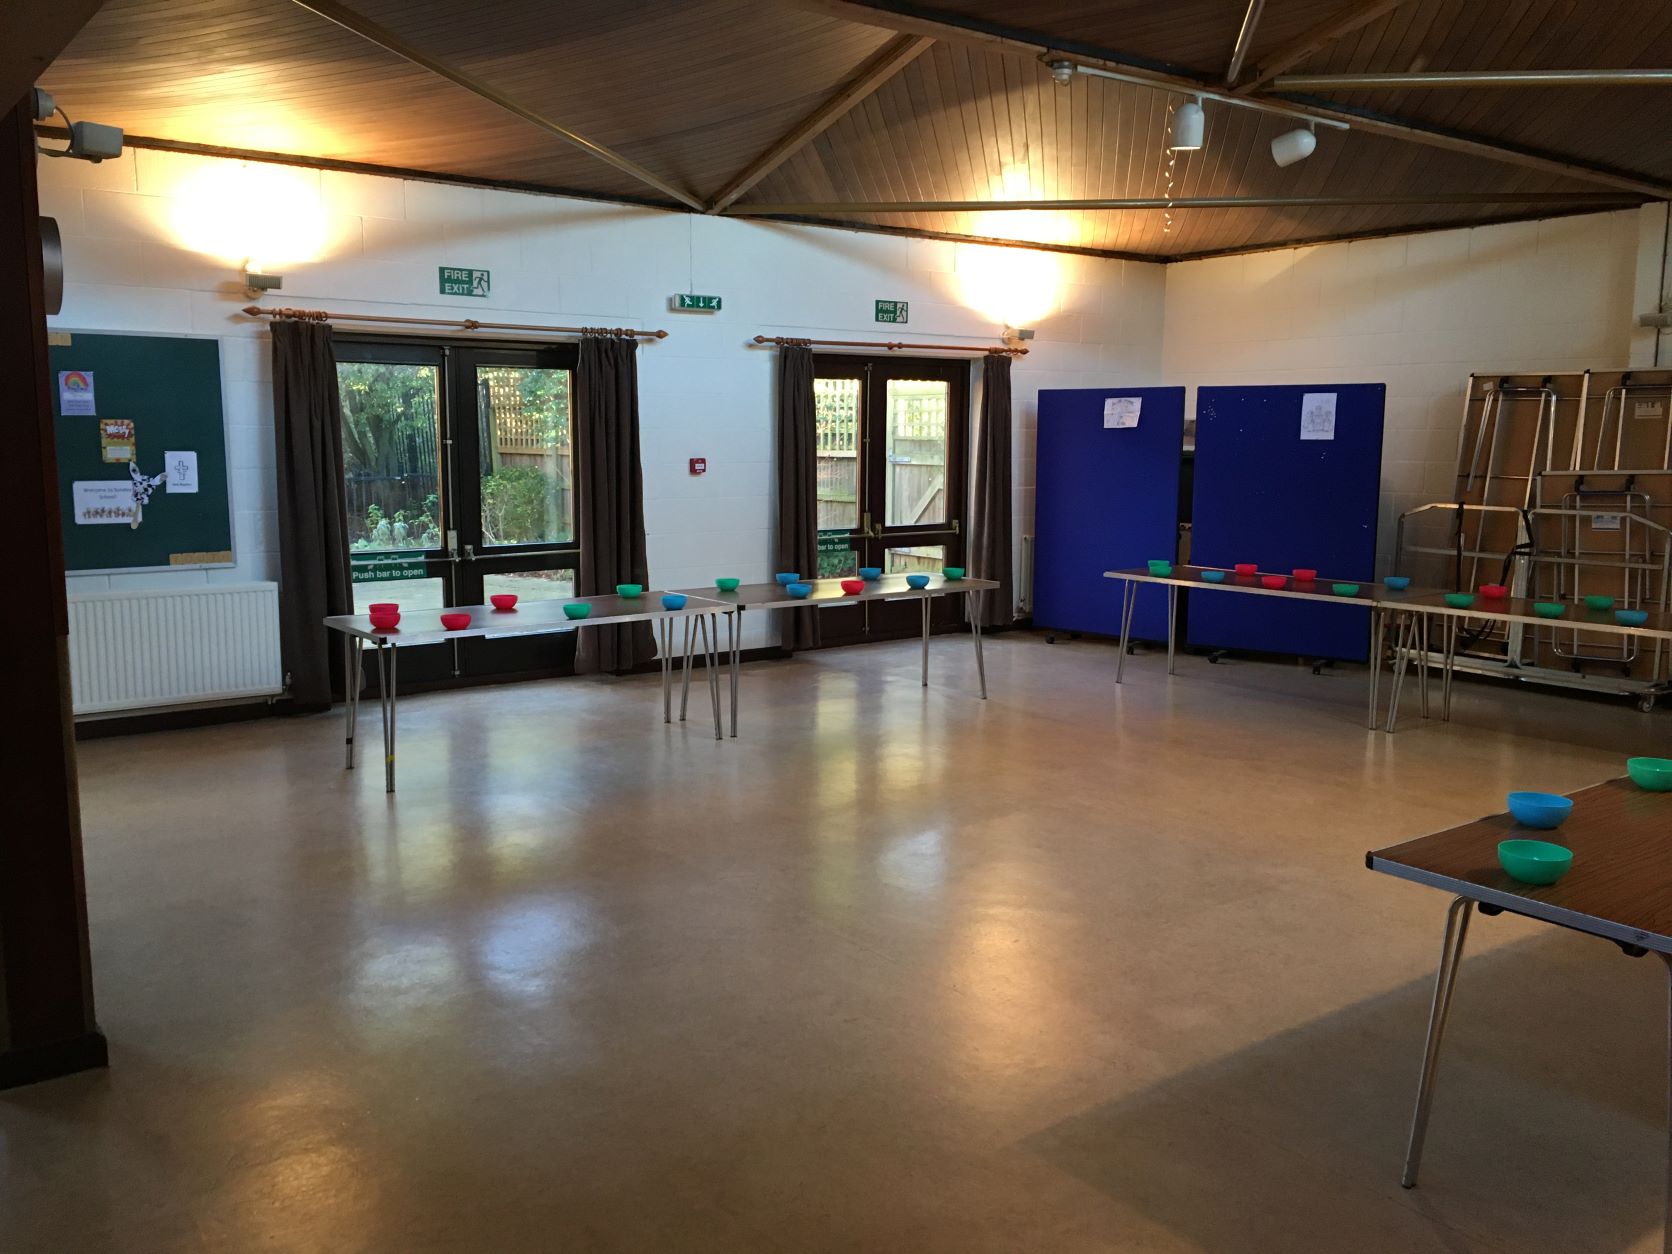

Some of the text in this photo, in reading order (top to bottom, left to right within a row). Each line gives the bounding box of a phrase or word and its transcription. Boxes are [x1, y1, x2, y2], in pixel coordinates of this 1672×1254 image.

[444, 269, 469, 280] FIRE
[445, 283, 468, 294] EXIT
[878, 302, 895, 311] FIRE
[878, 312, 895, 321] EXIT
[352, 571, 374, 579] Push
[402, 568, 424, 578] open
